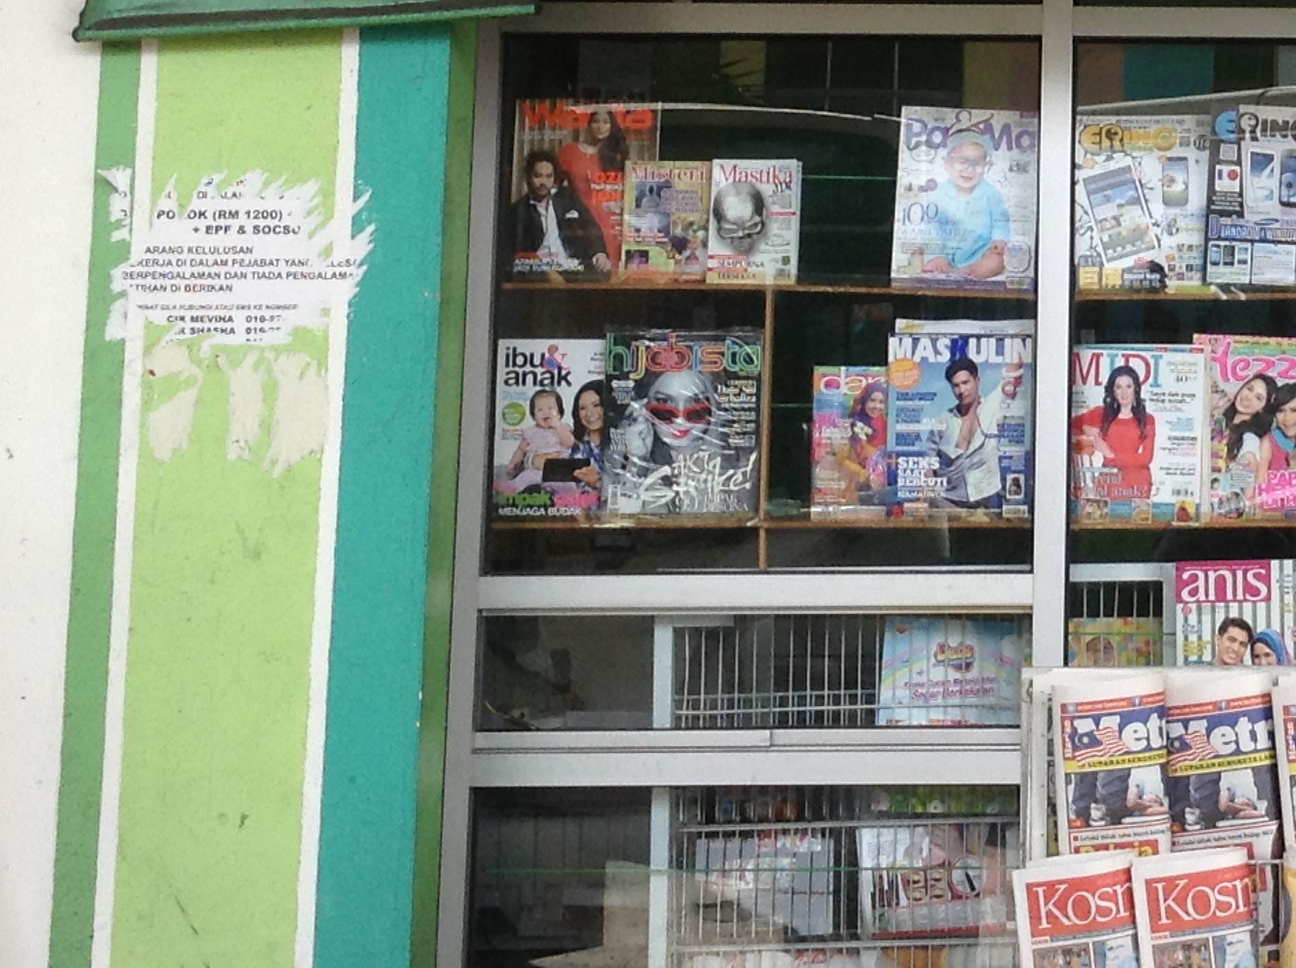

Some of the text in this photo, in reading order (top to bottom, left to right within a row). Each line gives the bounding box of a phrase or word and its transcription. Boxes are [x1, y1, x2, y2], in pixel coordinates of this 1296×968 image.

[156, 209, 283, 222] POOK (RM 1200)
[205, 225, 232, 234] EPF
[236, 225, 247, 234] &
[187, 246, 254, 255] KELULUSAN
[176, 258, 187, 268] DI
[190, 258, 228, 268] DALAM
[232, 258, 280, 268] PEJABAT
[224, 271, 248, 280] DAN
[252, 271, 283, 280] TIADA
[888, 336, 1032, 363] MASKULIN
[503, 368, 572, 388] anak
[1180, 567, 1269, 601] anis
